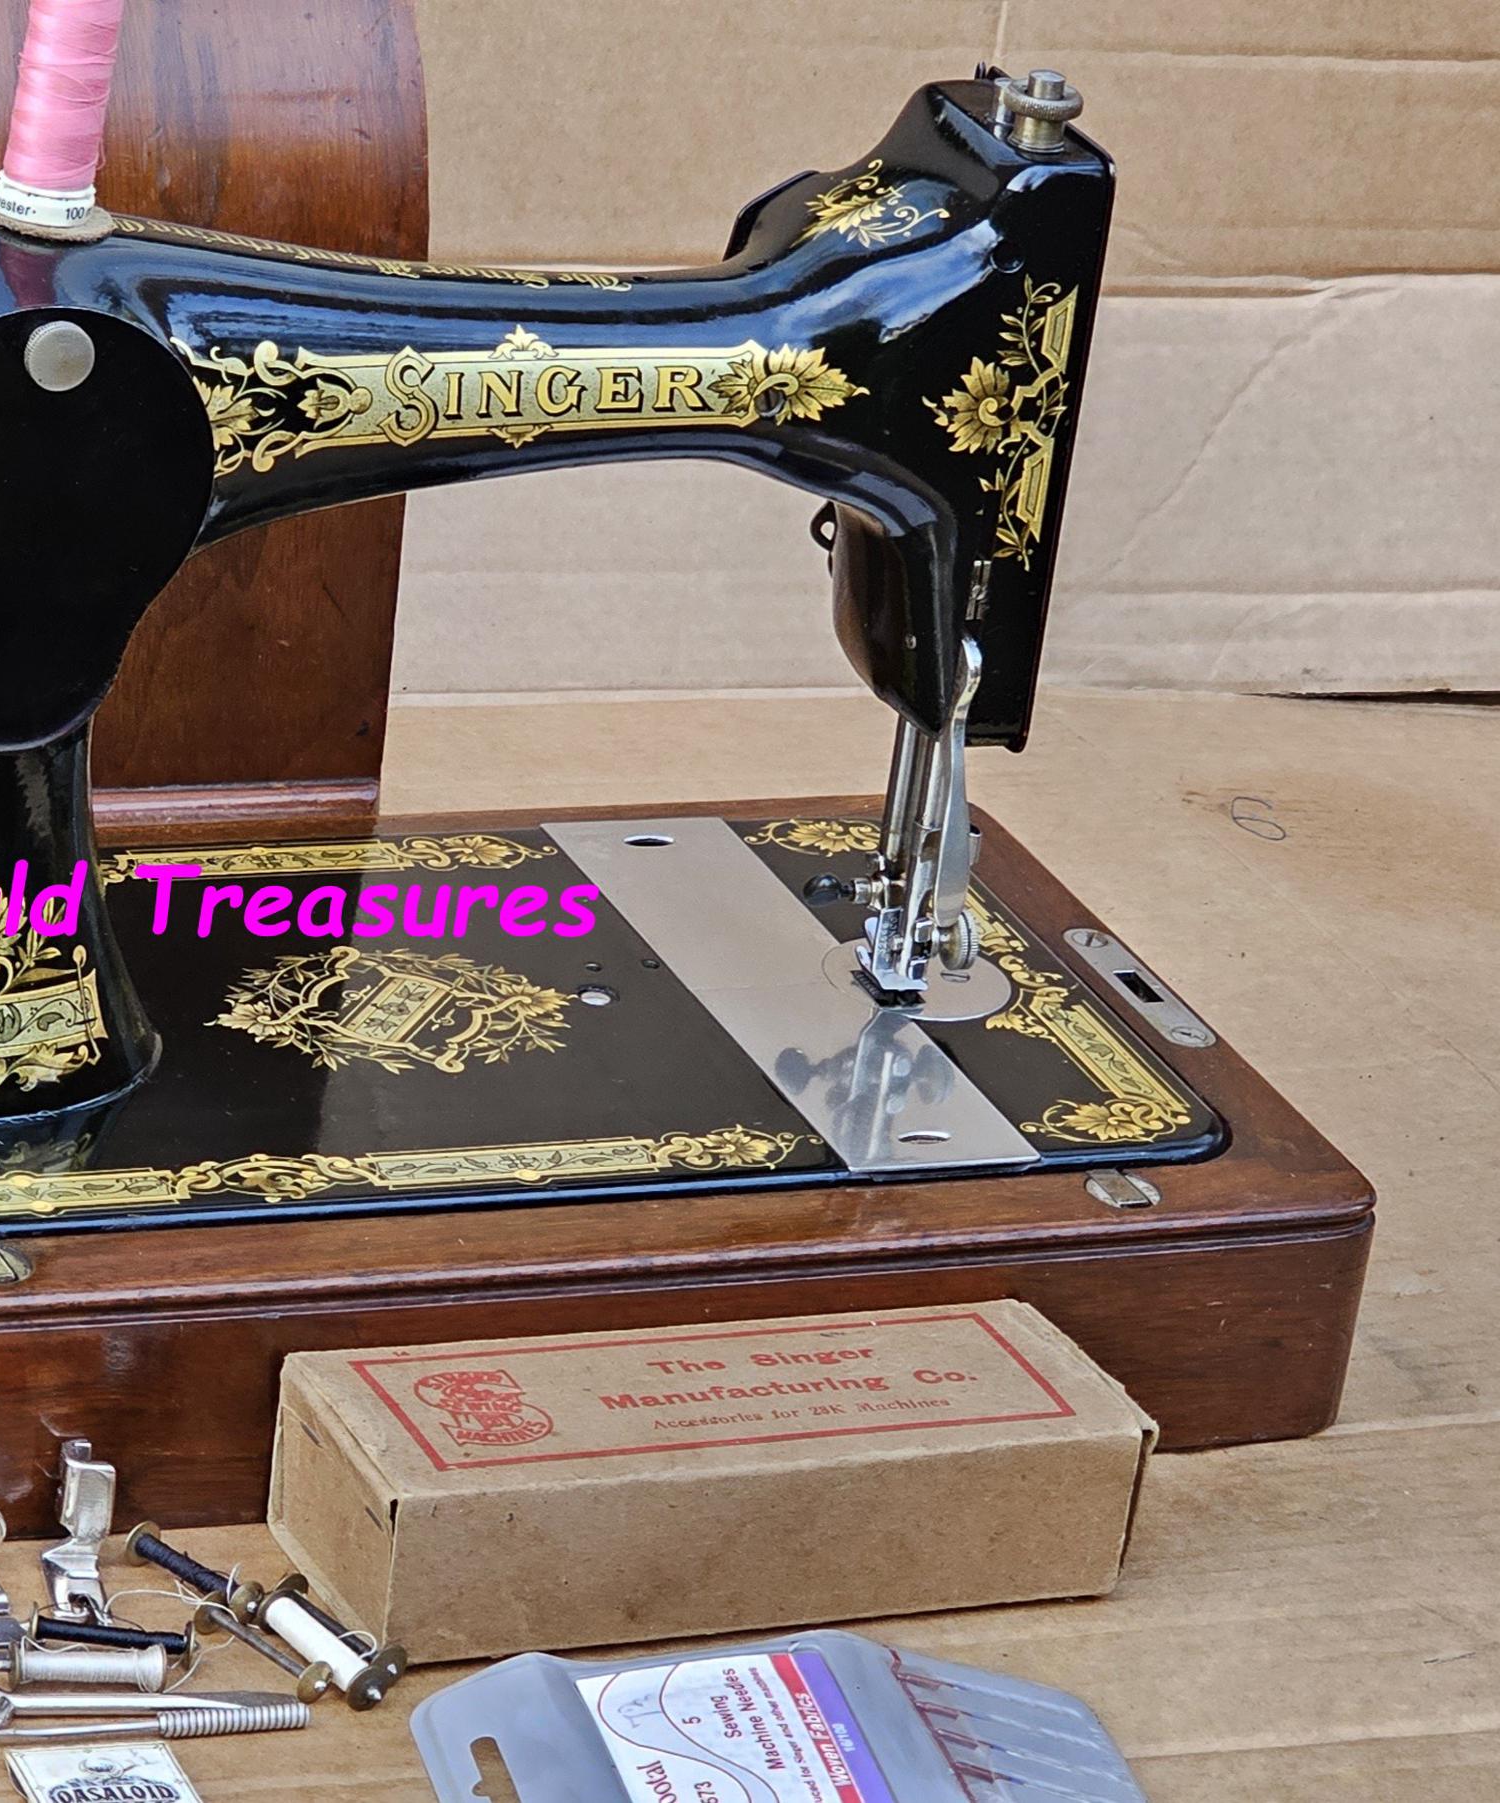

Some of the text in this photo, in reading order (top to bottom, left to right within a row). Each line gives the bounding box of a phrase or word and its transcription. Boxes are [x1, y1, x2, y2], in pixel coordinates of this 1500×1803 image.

[65, 206, 85, 220] 100
[384, 346, 713, 447] SINGER
[647, 1346, 874, 1376] The Singer
[599, 1368, 979, 1411] Manufacturing Co.
[653, 1411, 764, 1431] Accessories
[771, 1408, 799, 1419] for
[856, 1398, 951, 1413] Machines
[681, 1716, 702, 1724] 5
[710, 1695, 742, 1738] Sewing
[722, 1668, 786, 1769] Machine Needles
[794, 1692, 852, 1787] Woven Fabrics
